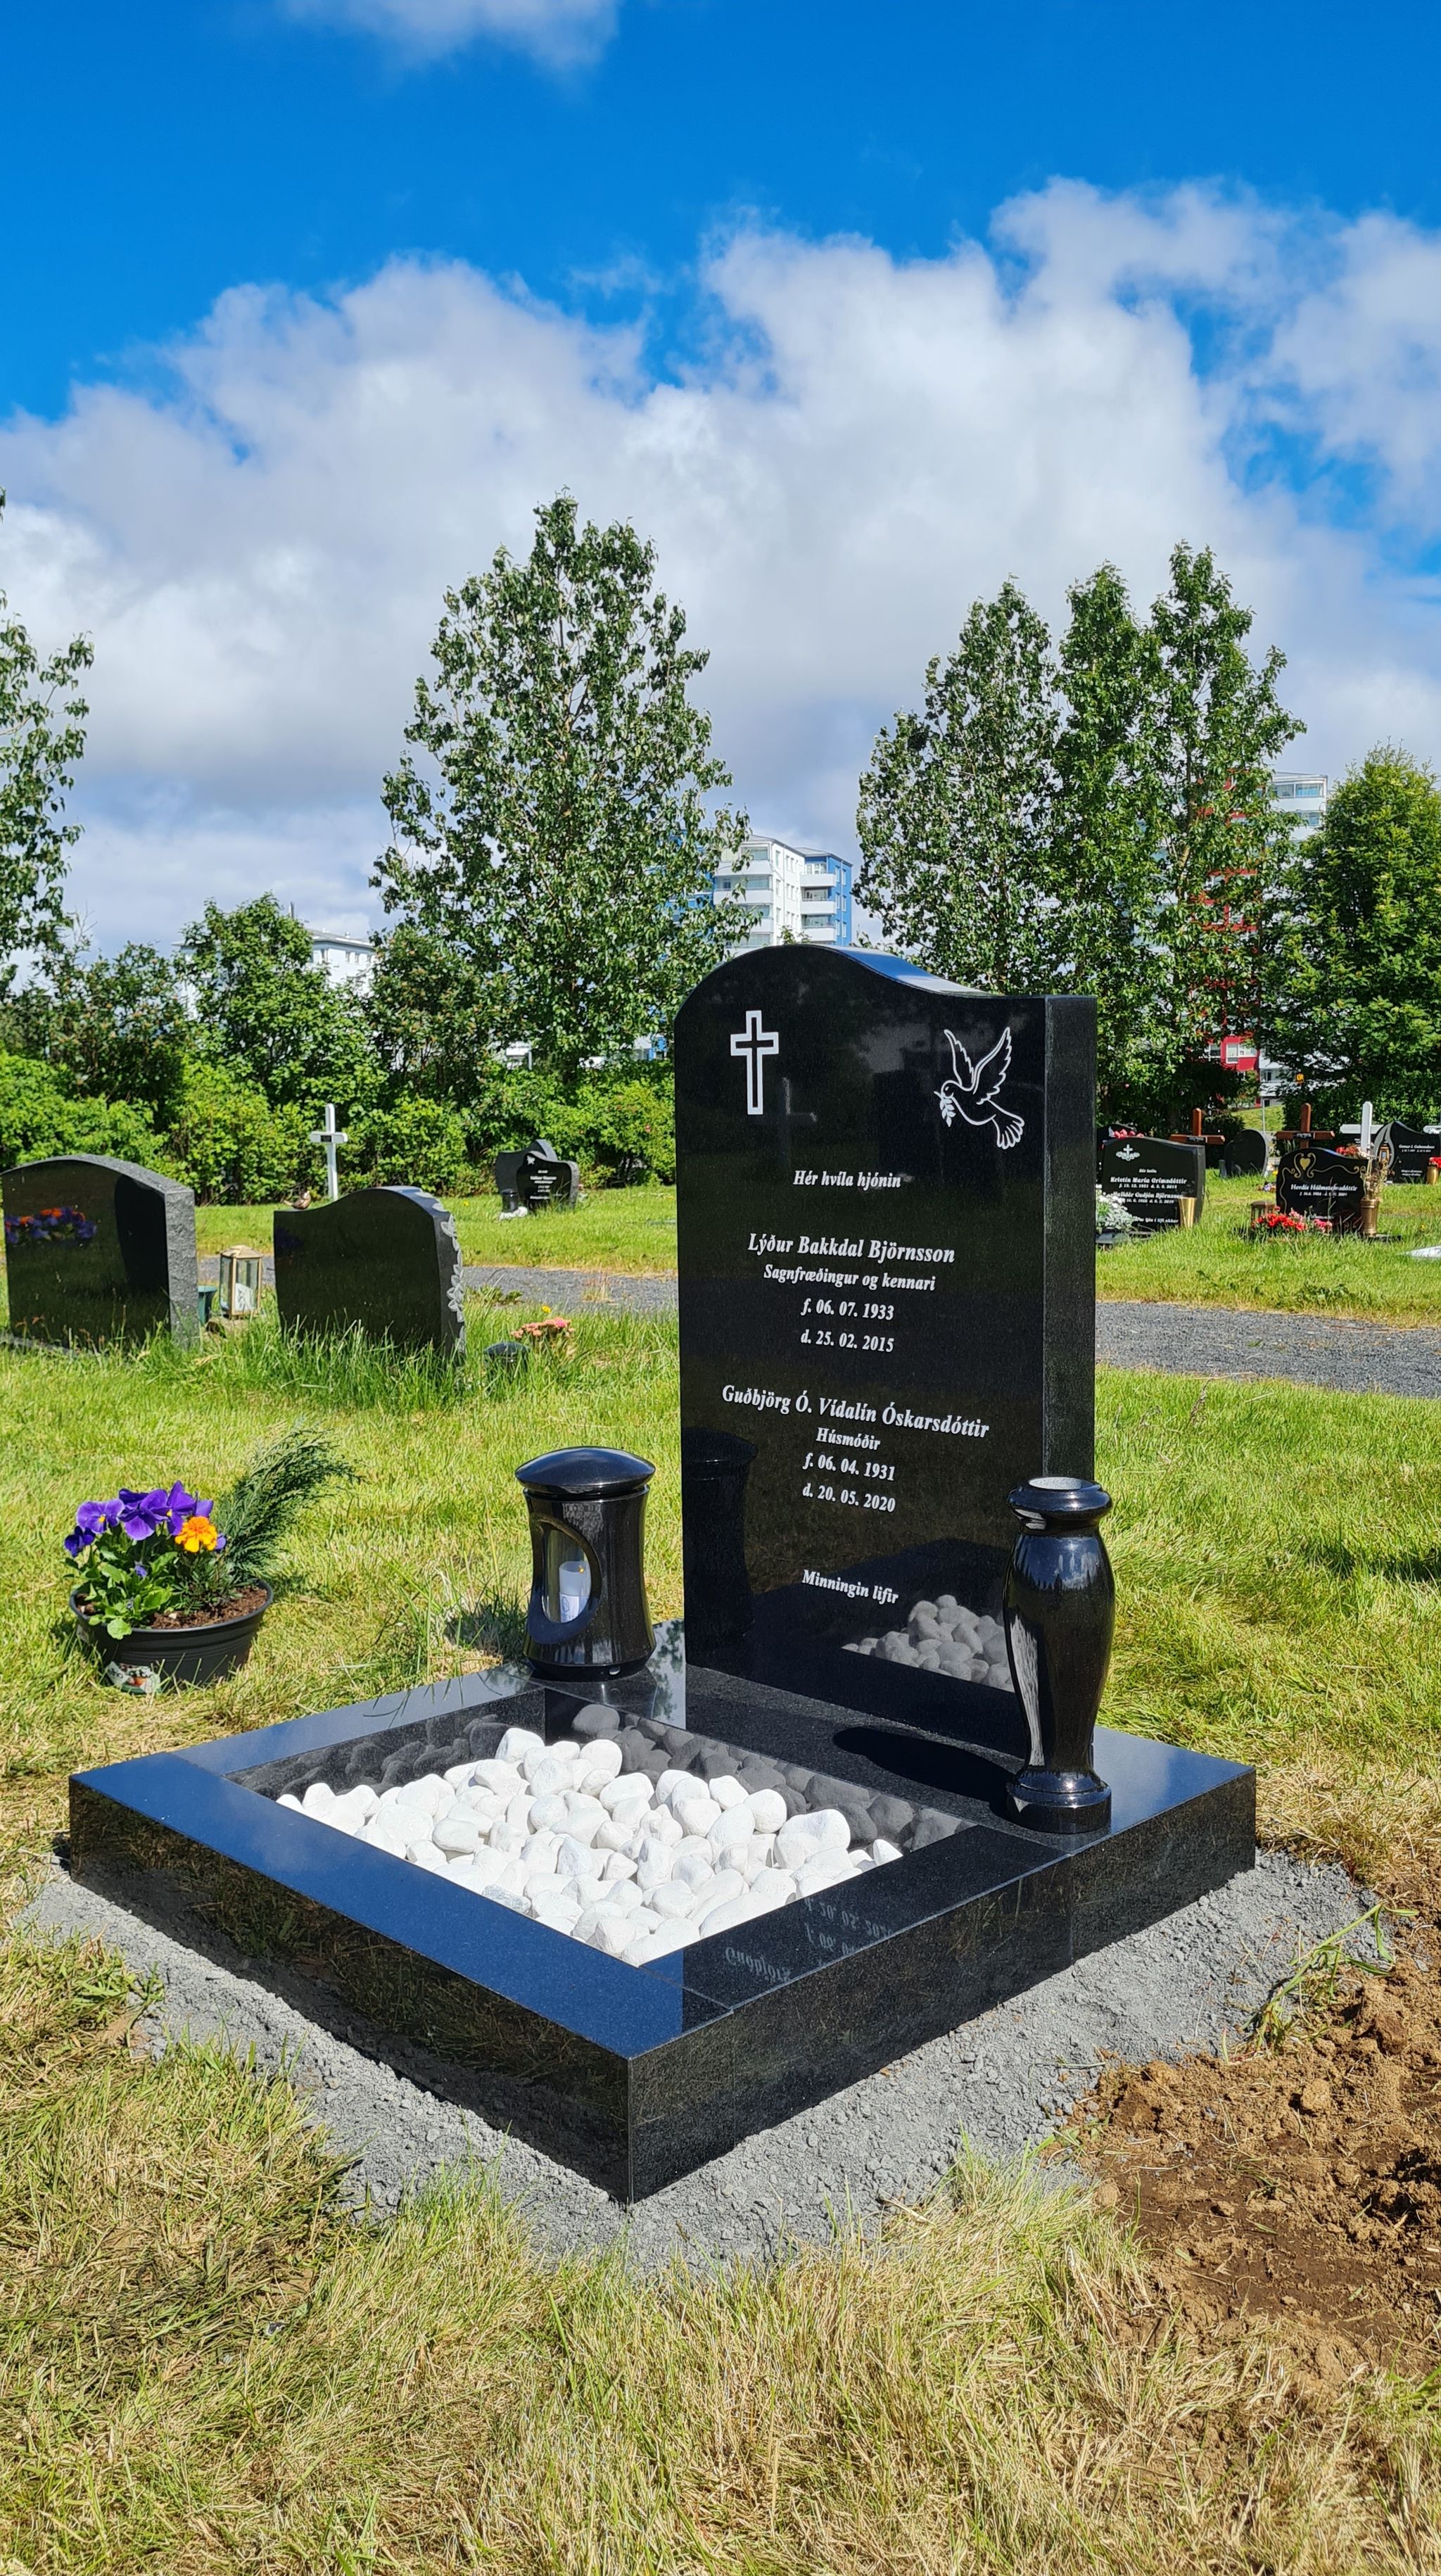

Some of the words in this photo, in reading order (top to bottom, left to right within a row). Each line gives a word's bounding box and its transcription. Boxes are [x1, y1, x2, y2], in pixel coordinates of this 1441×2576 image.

[793, 1170, 818, 1185] Hér
[821, 1170, 853, 1187] hvíla
[856, 1171, 901, 1191] hjónin
[747, 1232, 794, 1256] Lýður
[796, 1236, 864, 1258] Bakkdal
[867, 1239, 956, 1264] Björnsson
[763, 1263, 858, 1288] Sagnfræðingur
[862, 1275, 878, 1291] og
[882, 1272, 936, 1291] kennari
[800, 1298, 812, 1316] f.
[815, 1299, 834, 1315] 06.
[839, 1301, 858, 1318] 07.
[862, 1303, 894, 1320] 1933
[800, 1329, 811, 1344] d.
[815, 1330, 834, 1346] 25.
[839, 1332, 858, 1349] 02.
[862, 1335, 894, 1353] 2015
[722, 1384, 792, 1415] Guðbjörg
[795, 1389, 812, 1413] Ó.
[819, 1397, 877, 1422] Vídalín
[882, 1401, 990, 1438] Óskarsdóttir
[815, 1427, 881, 1451] Húsmóðir
[802, 1452, 814, 1470] f.
[818, 1454, 837, 1471] 06.
[841, 1458, 859, 1475] 04.
[863, 1462, 895, 1481] 1931
[802, 1482, 813, 1498] d.
[817, 1485, 836, 1502] 20.
[840, 1489, 859, 1506] 05.
[863, 1493, 896, 1513] 2020
[801, 1569, 869, 1598] Minningin
[872, 1585, 899, 1605] lifir
